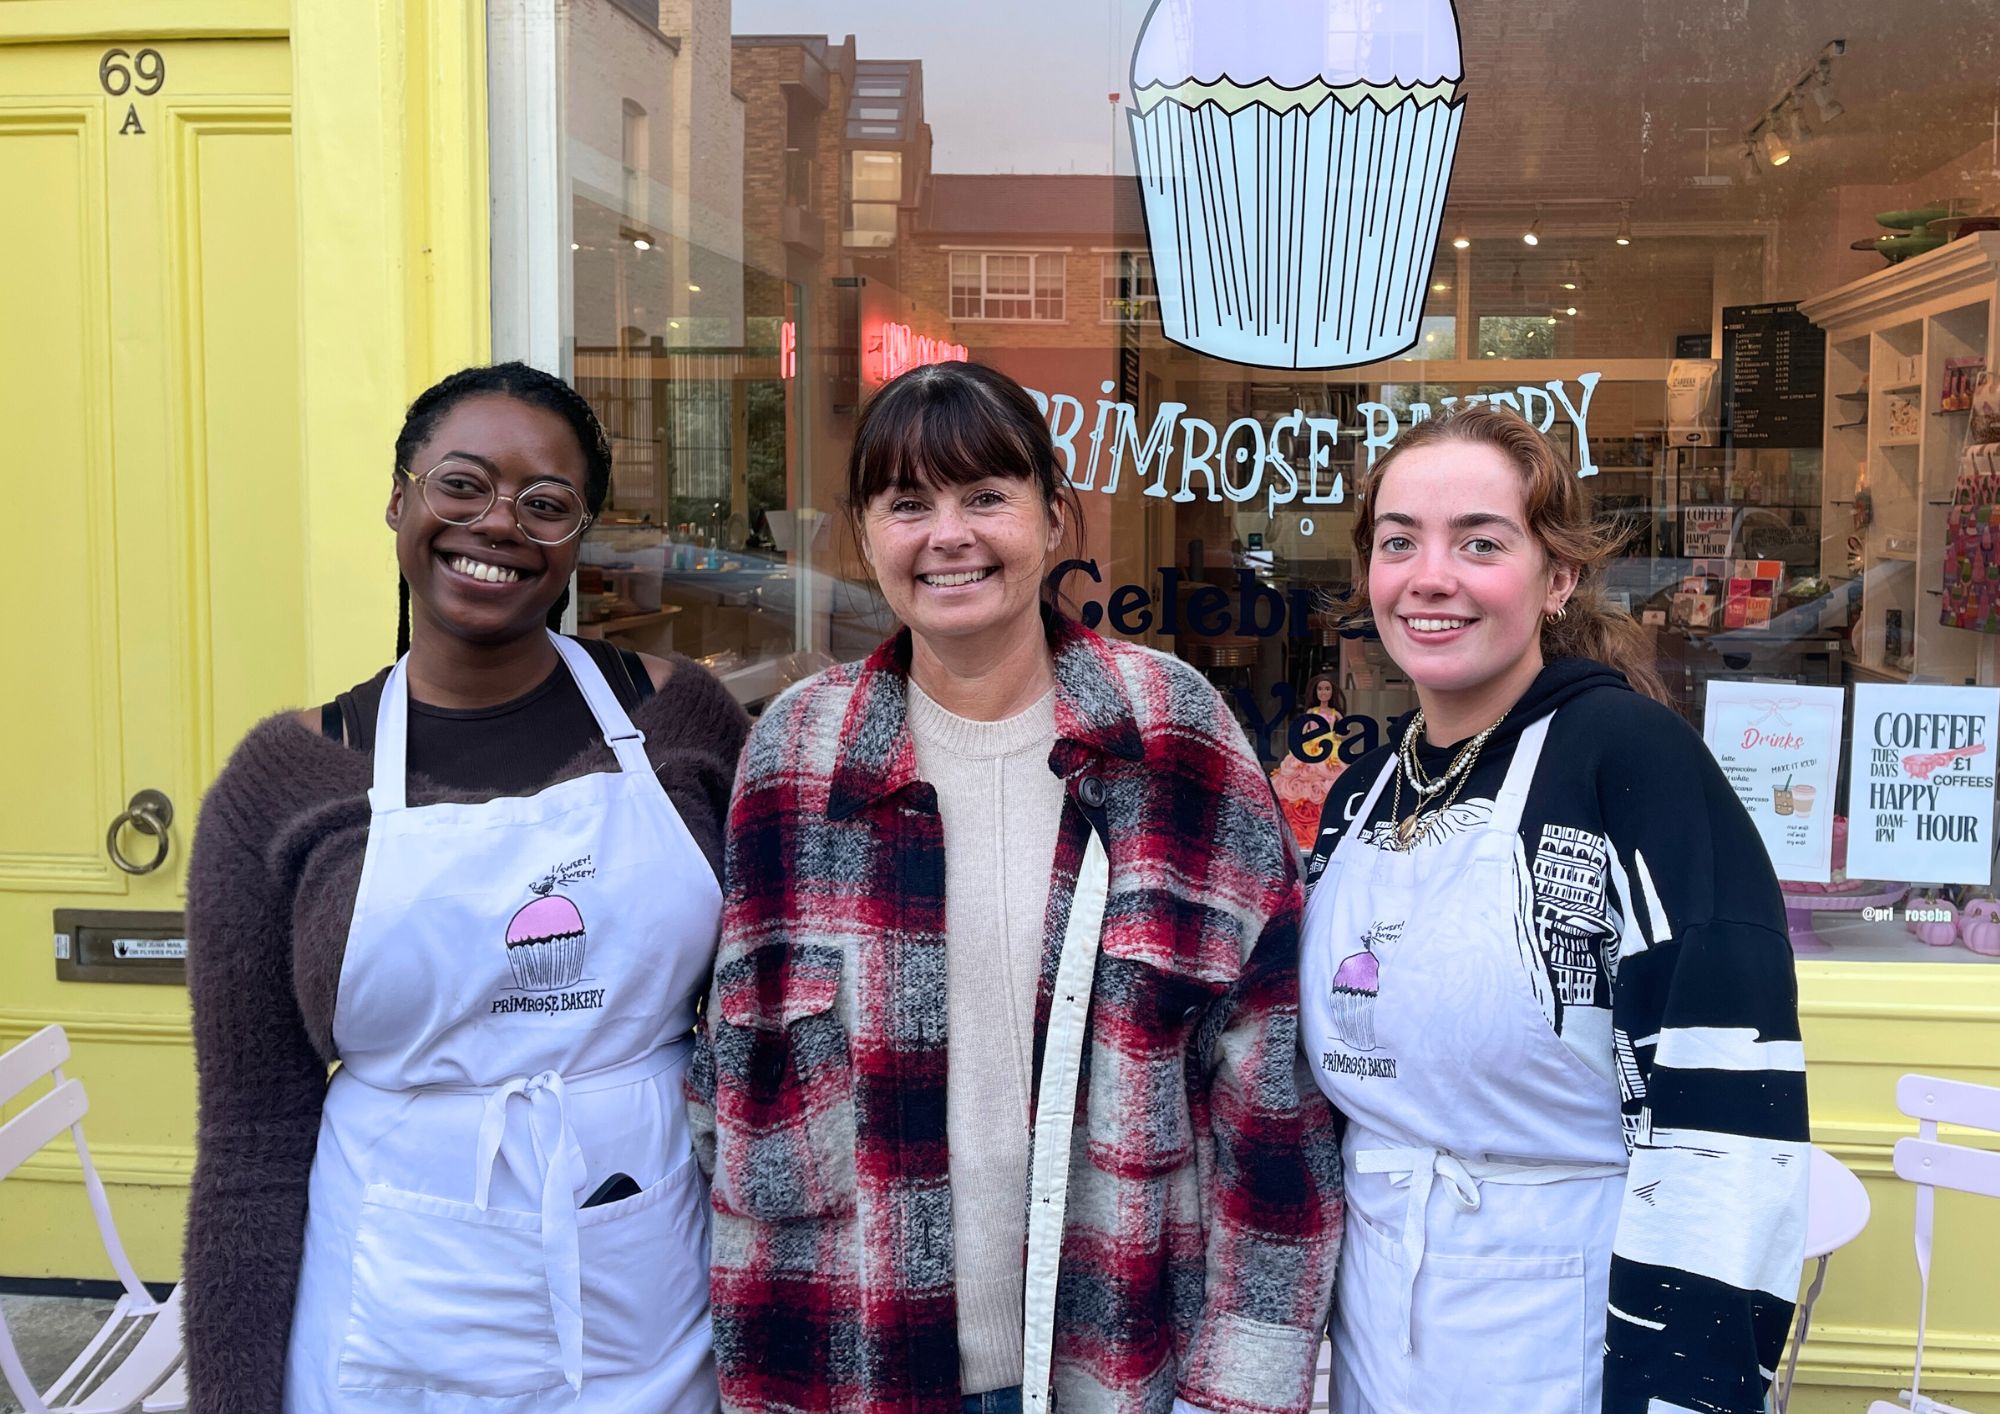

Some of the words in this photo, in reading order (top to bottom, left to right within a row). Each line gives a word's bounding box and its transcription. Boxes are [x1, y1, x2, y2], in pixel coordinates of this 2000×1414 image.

[99, 48, 165, 96] 69
[118, 102, 146, 135] A
[1022, 380, 1344, 519] RIMROSE
[1686, 508, 1728, 521] COFFEE
[1686, 533, 1711, 544] HAPPY
[1703, 544, 1726, 555] HOUR
[1874, 712, 1986, 749] COFFEE
[1741, 728, 1805, 750] Drinks
[1721, 754, 1736, 762] latte
[1872, 748, 1899, 762] TUES
[1771, 764, 1790, 774] MAKE
[1791, 762, 1798, 770] IT
[1870, 763, 1898, 777] DAYS
[1953, 757, 1971, 771] £1
[1933, 775, 1994, 788] COFFEES
[1869, 783, 1940, 811] HAPPY
[1875, 828, 1895, 842] 1PM
[1876, 814, 1909, 828] 10AM-
[1916, 814, 1979, 843] HOUR
[559, 855, 592, 873] SWEET!
[562, 868, 596, 881] SWEET!
[491, 994, 559, 1016] PRIMROSE
[561, 989, 606, 1011] BAKERY
[1322, 1050, 1368, 1081] PRIMROSE
[1368, 1056, 1397, 1079] BAKERY
